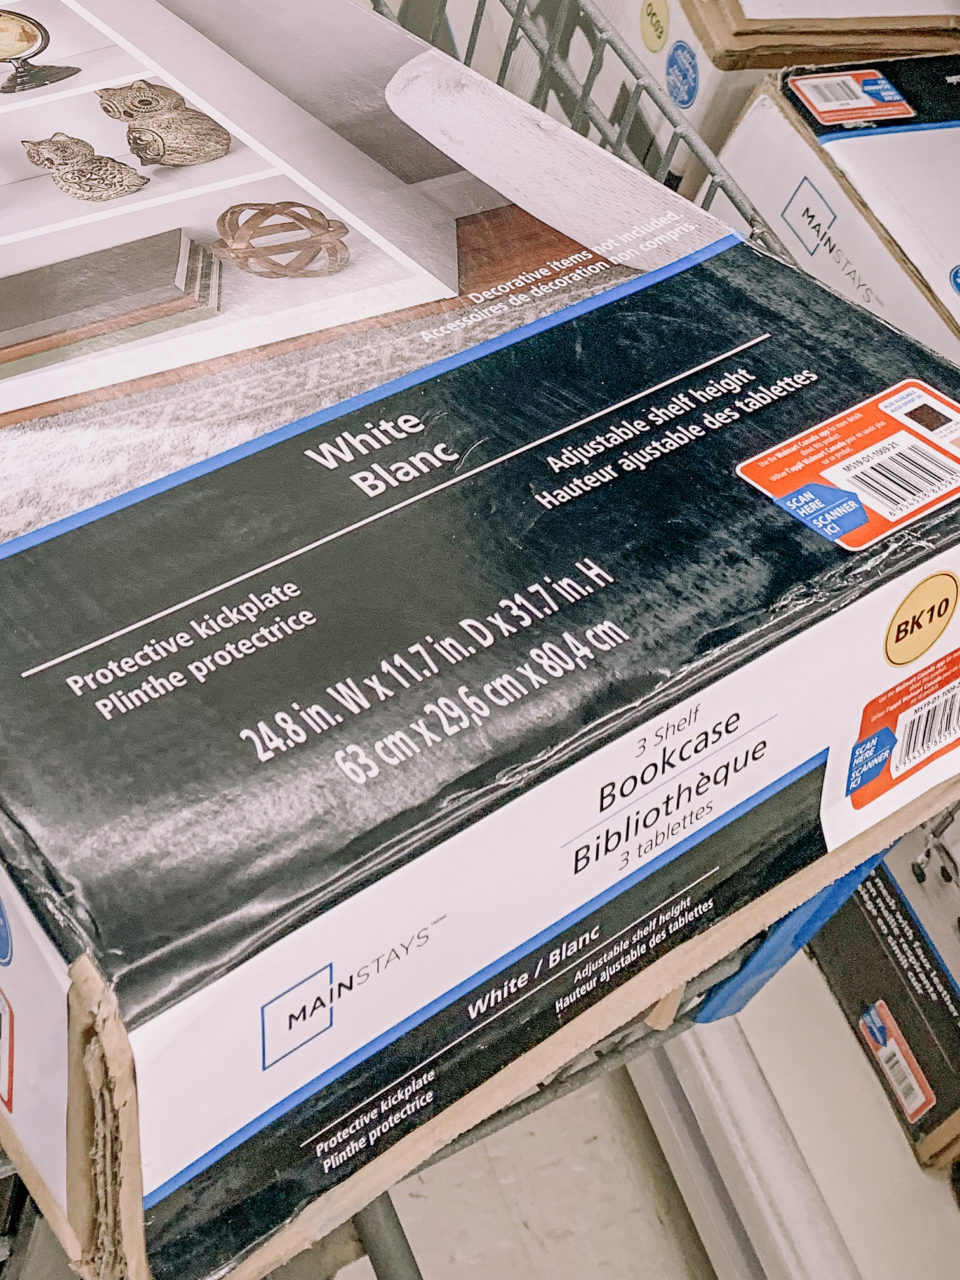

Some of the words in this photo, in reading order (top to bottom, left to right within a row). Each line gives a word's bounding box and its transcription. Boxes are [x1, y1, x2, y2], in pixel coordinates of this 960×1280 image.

[467, 266, 550, 305] Decorative
[549, 250, 593, 272] items
[592, 238, 615, 258] not
[618, 210, 685, 244] included.
[802, 207, 874, 306] MAINSTAYS
[420, 302, 510, 343] Accessoires
[508, 291, 530, 307] de
[530, 260, 610, 298] décoration
[610, 248, 639, 267] non
[639, 222, 701, 253] compris.
[304, 410, 426, 472] White
[534, 466, 619, 511] Hauteur
[621, 423, 707, 474] ajustable
[704, 403, 742, 434] des
[737, 367, 819, 415] tablettes
[546, 418, 650, 475] Adjustable
[646, 393, 696, 431] shelf
[693, 368, 757, 411] height
[350, 437, 461, 499] Blanc
[786, 492, 816, 510] SCAN
[796, 498, 826, 518] HERE
[812, 500, 860, 528] SCANNER
[823, 523, 841, 536] ICI
[543, 575, 595, 604] in.
[575, 557, 615, 584] H
[488, 614, 518, 638] x
[499, 583, 559, 628] 31.7
[894, 598, 950, 644] BK10
[65, 628, 194, 698] Protective
[192, 579, 303, 640] kickplate
[427, 635, 477, 665] in.
[459, 618, 495, 649] D
[529, 632, 596, 678] 80,4
[585, 618, 631, 652] cm
[94, 668, 188, 721] Plinthe
[186, 606, 318, 680] protectrice
[380, 645, 440, 689] 11.7
[516, 663, 548, 690] x
[326, 677, 371, 715] W
[363, 677, 394, 702] x
[424, 686, 491, 737] 29,6
[483, 673, 527, 707] cm
[239, 711, 307, 763] 24.8
[291, 701, 344, 735] in.
[410, 717, 442, 747] x
[635, 737, 646, 758] 3
[653, 703, 702, 747] Shelf
[334, 745, 380, 785] 63
[375, 721, 421, 766] cm
[599, 713, 740, 813] Bookcase
[850, 750, 890, 781] SCANNER
[853, 748, 875, 767] HERE
[854, 736, 878, 758] SCAN
[849, 775, 861, 791] ICI
[574, 740, 767, 875] Bibliothèque
[618, 851, 630, 871] 3
[637, 800, 713, 858] tablettes
[554, 980, 599, 1014] Hauteur
[599, 944, 648, 983] ajustable
[648, 932, 668, 949] des
[667, 896, 714, 944] tablettes
[573, 939, 630, 984] Adjustable
[631, 916, 659, 946] shelf
[658, 895, 691, 927] height
[875, 877, 896, 910] mesh
[895, 911, 913, 941] with
[913, 942, 932, 971] faux
[931, 972, 959, 1017] leather
[288, 932, 430, 1030] MAINSTAYS
[467, 972, 529, 1021] White
[534, 959, 544, 978] /
[548, 925, 601, 970] Blanc
[315, 1108, 378, 1157] Protective
[380, 1070, 435, 1114] kickplate
[323, 1136, 367, 1174] Plinthe
[368, 1090, 434, 1146] protectrice
